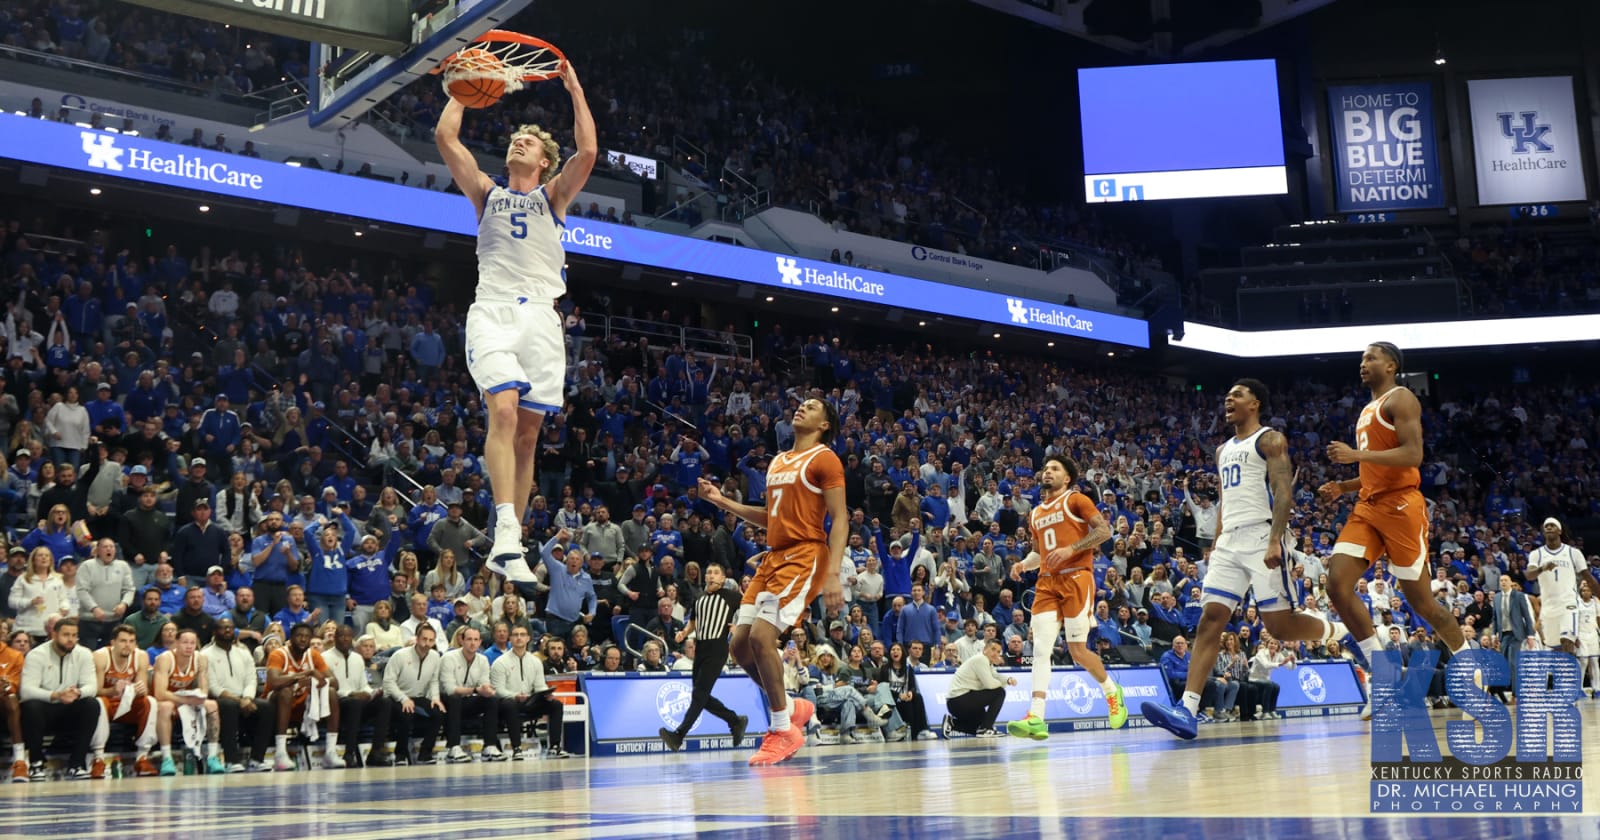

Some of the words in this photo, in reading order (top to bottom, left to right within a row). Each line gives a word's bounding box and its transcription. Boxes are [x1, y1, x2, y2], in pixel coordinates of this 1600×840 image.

[1342, 94, 1392, 109] HOME
[1395, 92, 1419, 106] TO
[1344, 107, 1422, 143] BIG
[1497, 111, 1554, 154] UK
[80, 132, 124, 171] UK
[127, 147, 263, 190] HealthCare
[1347, 143, 1424, 168] BLUE
[1492, 158, 1567, 171] HealthCare
[1349, 168, 1427, 185] DETERMI
[1099, 180, 1110, 195] C
[510, 212, 528, 239] 5
[1358, 213, 1386, 222] 235
[928, 252, 950, 264] Central
[952, 256, 967, 266] Bank
[776, 256, 803, 286] UK
[804, 267, 884, 296] HealthCare
[1029, 307, 1094, 332] HealthCare
[1223, 463, 1241, 489] 00
[770, 488, 783, 517] 7
[1035, 510, 1065, 530] TEXAS
[1044, 528, 1057, 550] 0
[1554, 569, 1559, 582] 1
[1584, 614, 1591, 624] 2
[615, 741, 646, 753] KENTUCKY
[647, 741, 663, 752] FARM
[700, 739, 710, 749] BIG
[711, 739, 719, 748] ON
